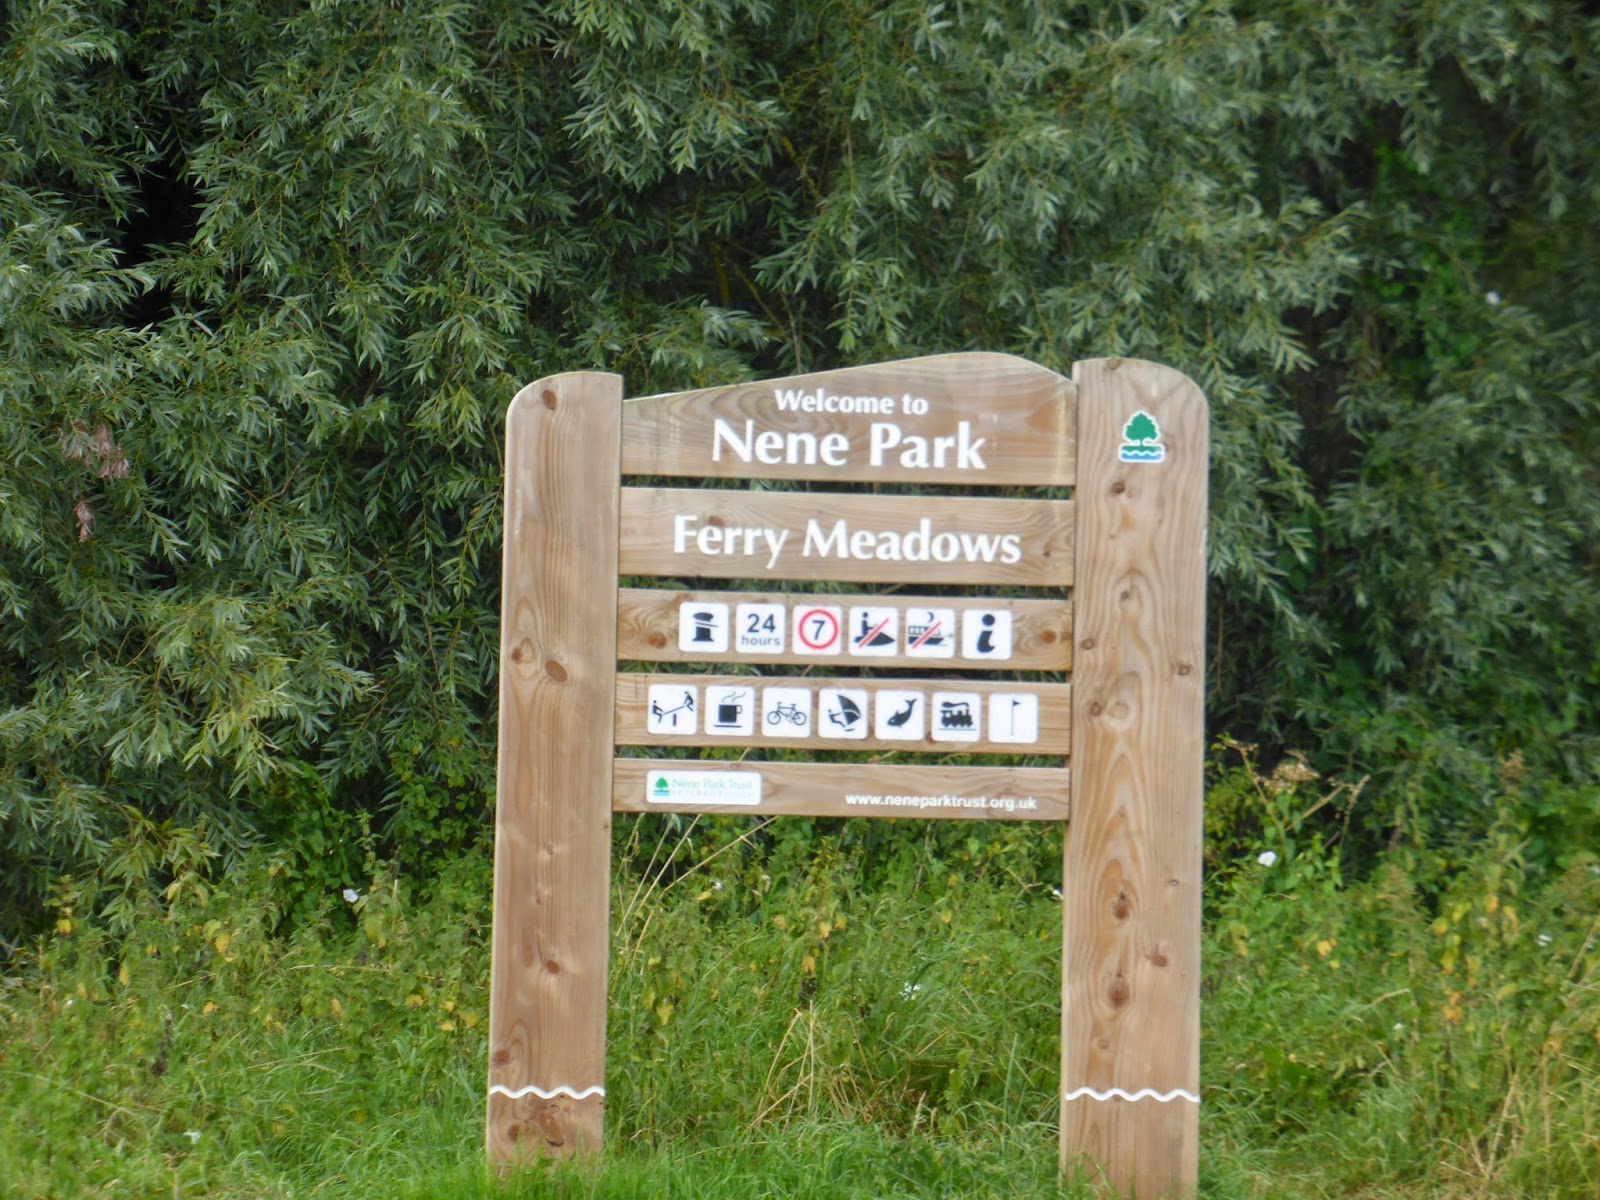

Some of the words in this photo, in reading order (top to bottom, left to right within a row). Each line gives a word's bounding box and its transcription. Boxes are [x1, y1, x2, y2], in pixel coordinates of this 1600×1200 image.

[773, 388, 895, 414] Welcome
[902, 393, 930, 416] to
[711, 418, 850, 467] Nene
[868, 420, 988, 470] Park
[673, 515, 791, 570] Ferry
[802, 518, 1022, 564] Meadows
[746, 613, 776, 633] 24
[811, 619, 825, 641] 7
[741, 635, 781, 648] hours
[703, 778, 725, 789] Park
[844, 794, 1038, 812] www.neneparktrust.org.uk
